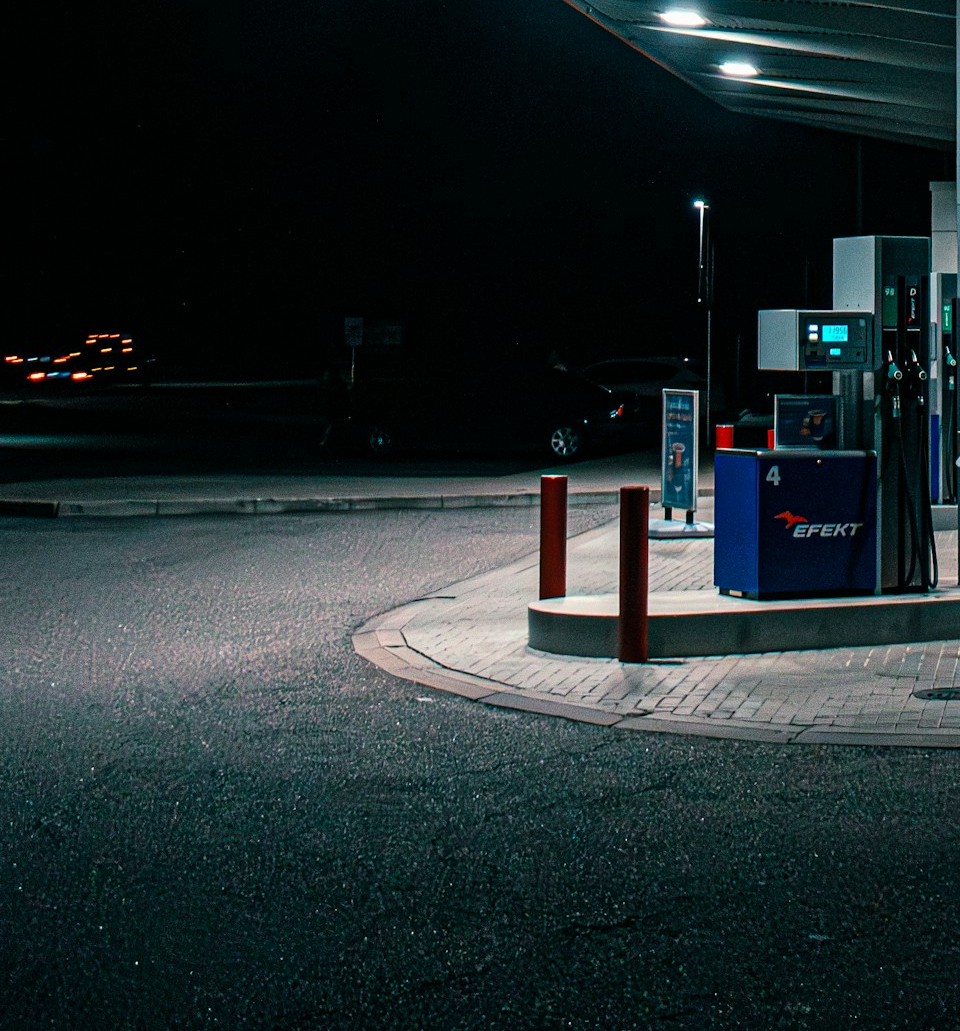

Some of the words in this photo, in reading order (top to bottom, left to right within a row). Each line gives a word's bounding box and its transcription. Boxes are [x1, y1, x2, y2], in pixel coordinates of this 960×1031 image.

[909, 287, 917, 297] D
[766, 465, 781, 486] 4
[792, 523, 863, 538] EFEKT
